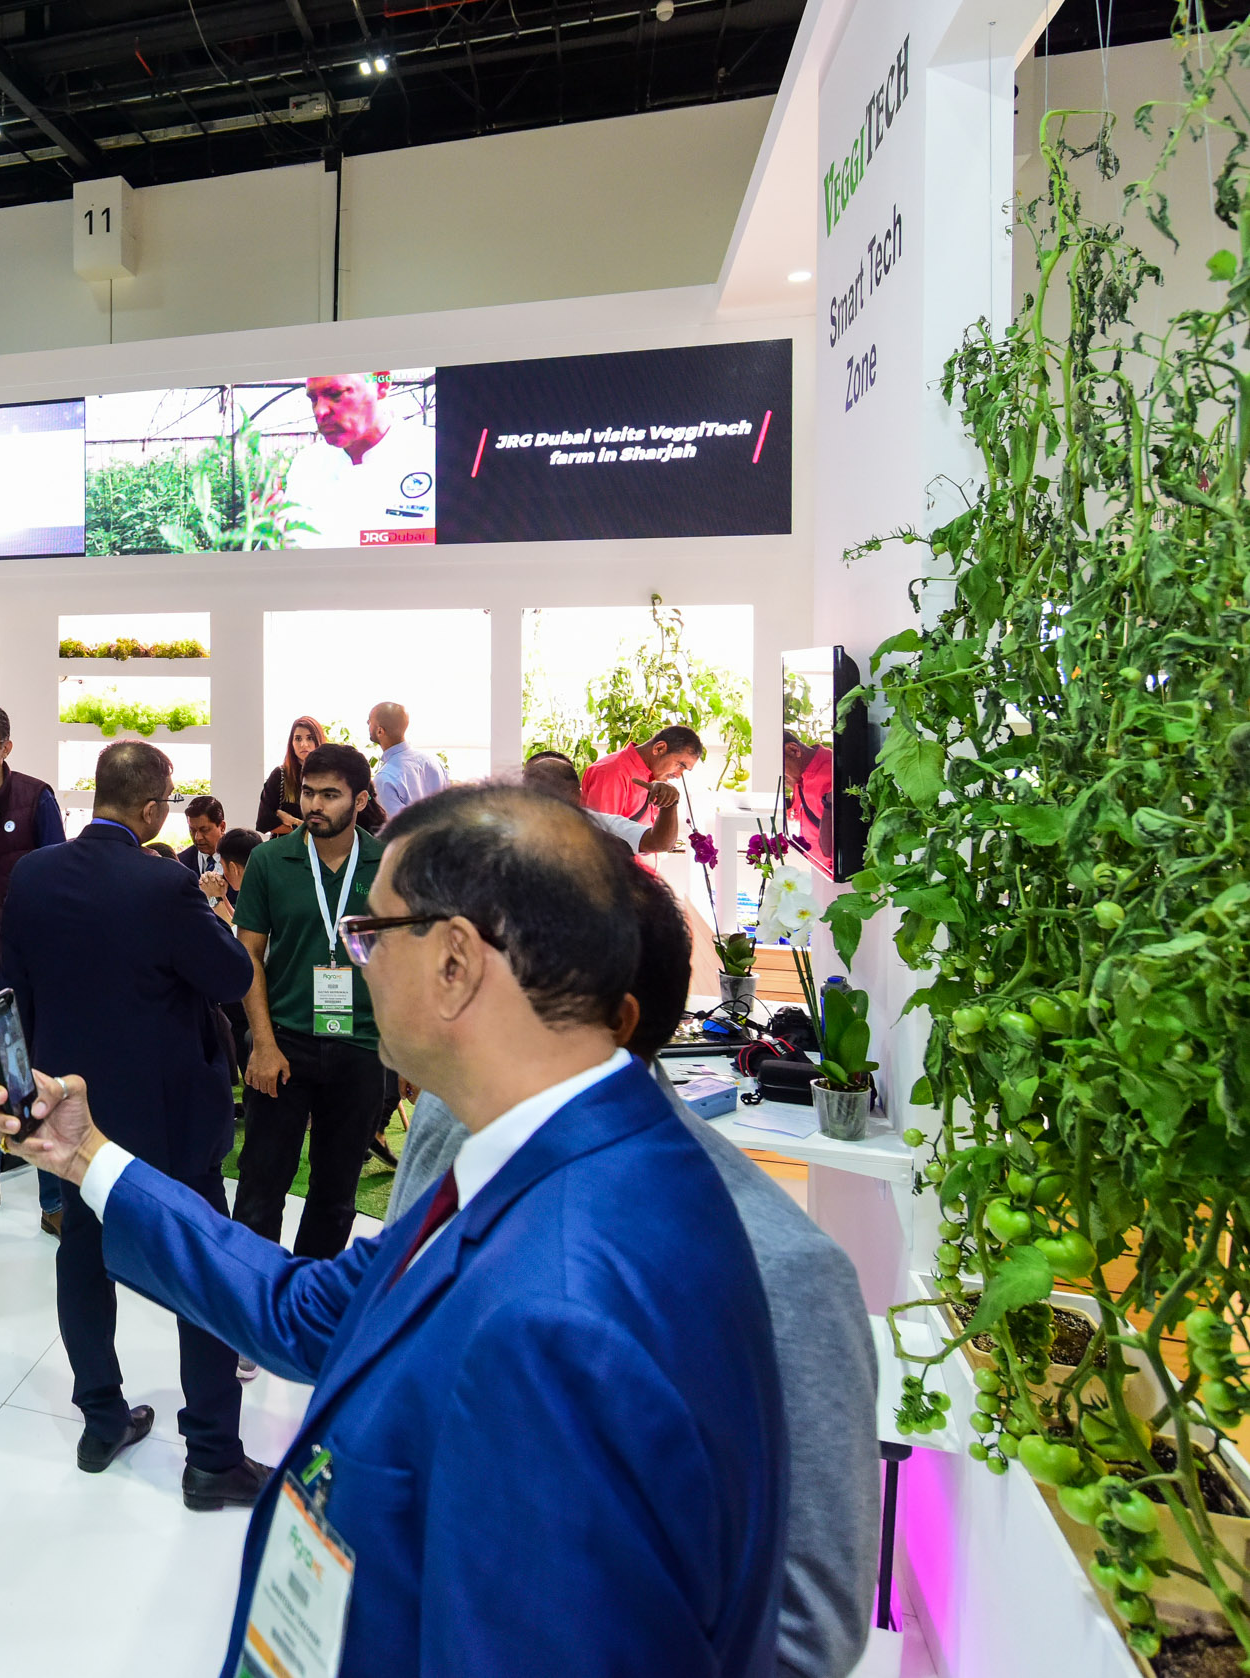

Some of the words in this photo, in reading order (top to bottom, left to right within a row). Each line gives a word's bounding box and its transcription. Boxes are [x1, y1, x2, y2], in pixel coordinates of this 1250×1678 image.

[84, 207, 110, 235] 11
[829, 255, 864, 348] Smart
[867, 203, 902, 296] Tech
[845, 342, 877, 413] Zone
[495, 433, 536, 449] JRG
[534, 428, 591, 447] Dubai
[593, 426, 646, 443] visits
[649, 419, 752, 442] VeggiTech
[549, 450, 595, 465] farm
[597, 446, 617, 463] in
[619, 443, 698, 462] Sharjah
